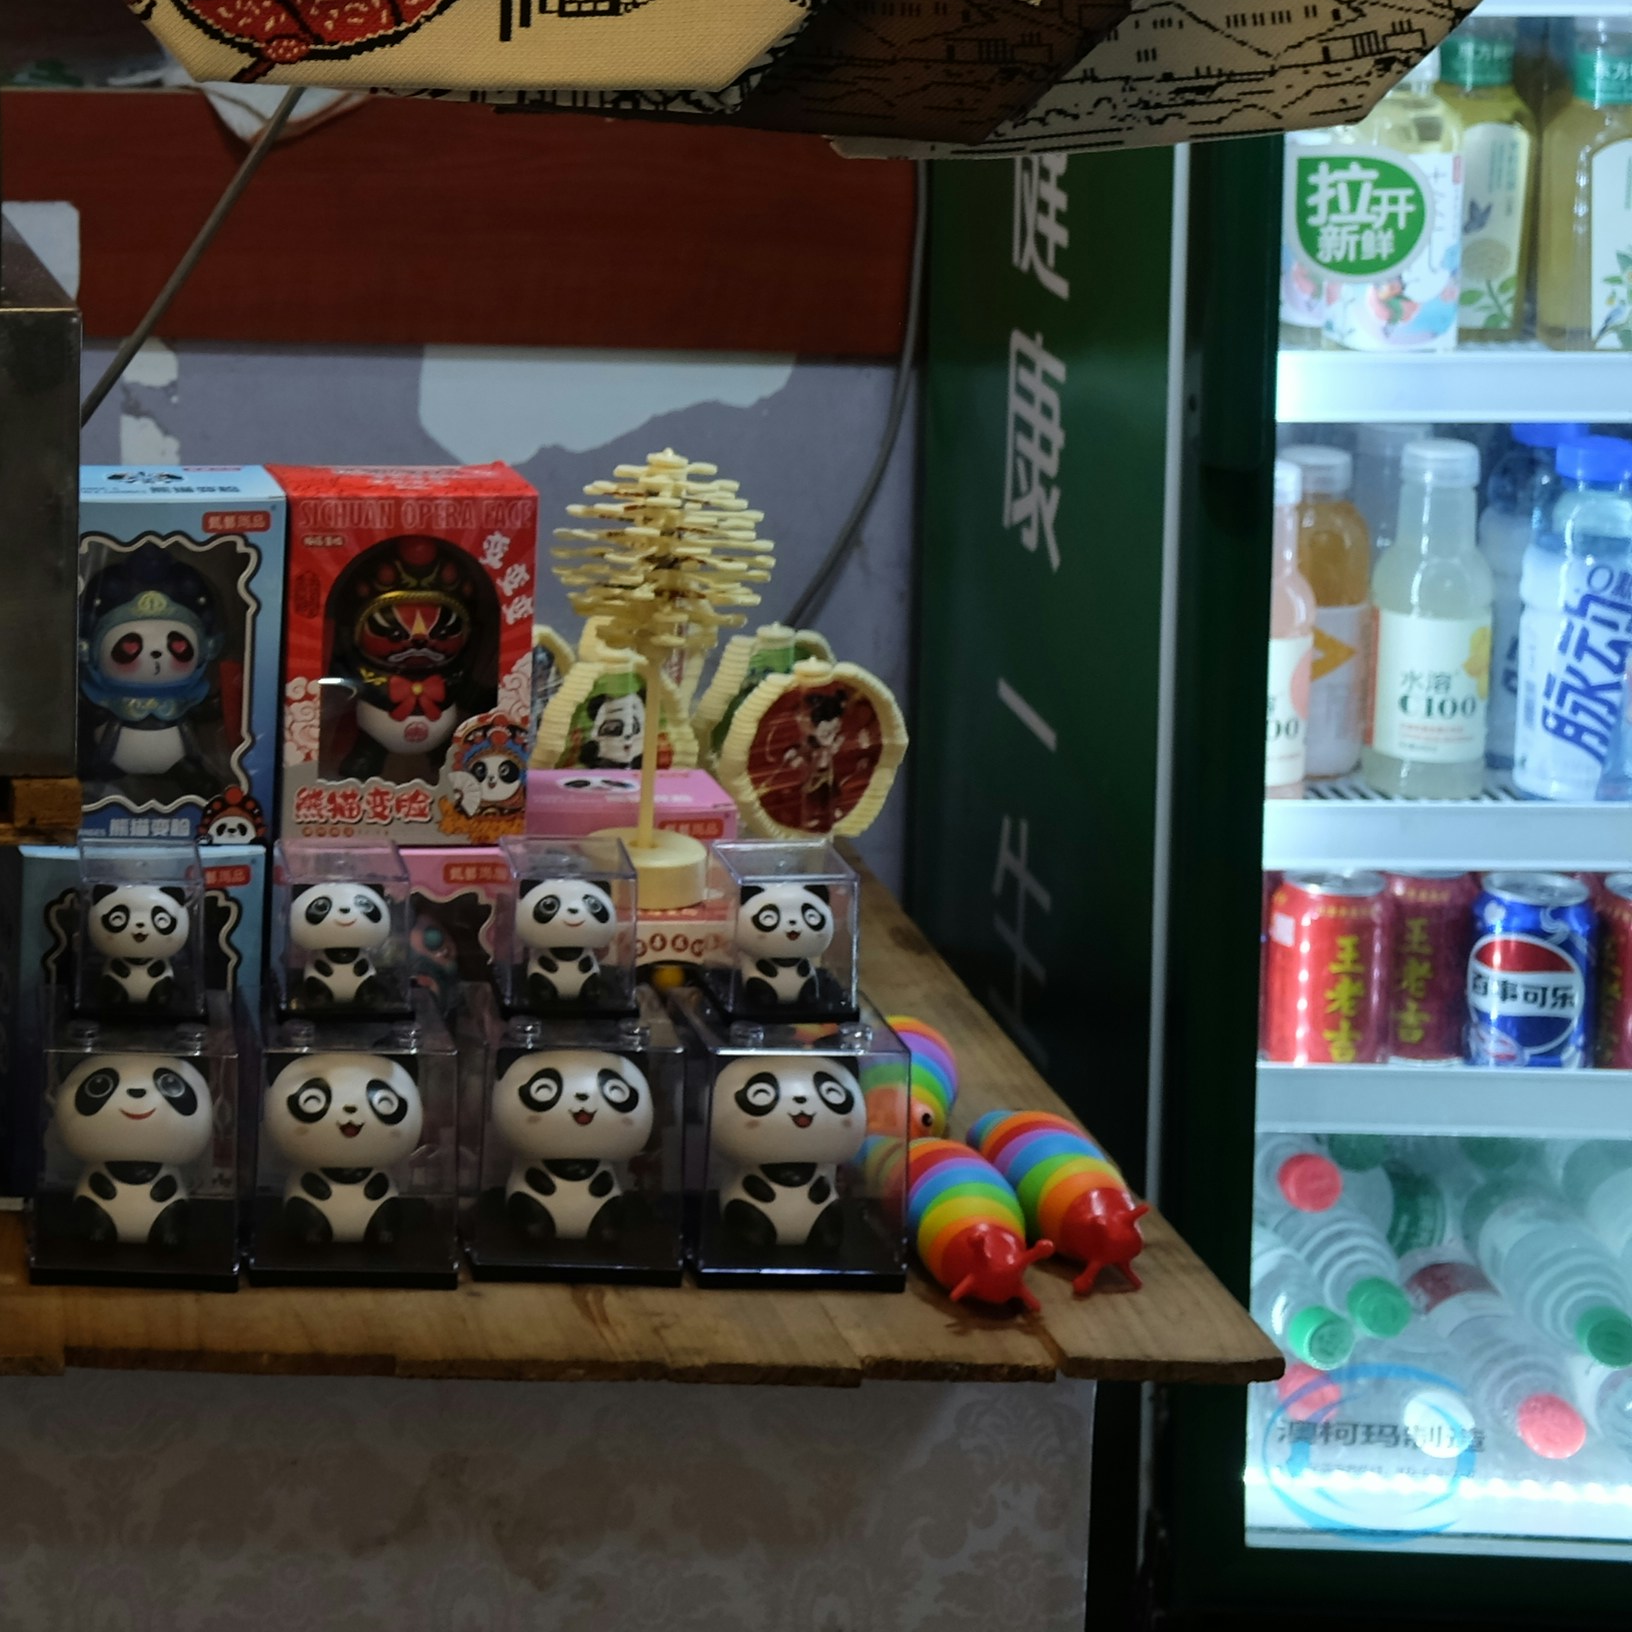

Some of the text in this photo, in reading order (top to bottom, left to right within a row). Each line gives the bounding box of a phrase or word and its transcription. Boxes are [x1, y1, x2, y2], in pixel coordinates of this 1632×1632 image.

[1307, 161, 1417, 230] 拉开
[1317, 223, 1395, 264] 新鲜
[298, 498, 395, 530] SICHUAN
[400, 498, 478, 529] OPERA
[483, 498, 535, 530] FACE
[1400, 671, 1453, 693] 水溶
[1398, 693, 1478, 721] C100
[293, 784, 434, 826] 熊猫变脸
[1323, 934, 1366, 1063] 王老吉
[1471, 974, 1576, 1010] 百事可乐
